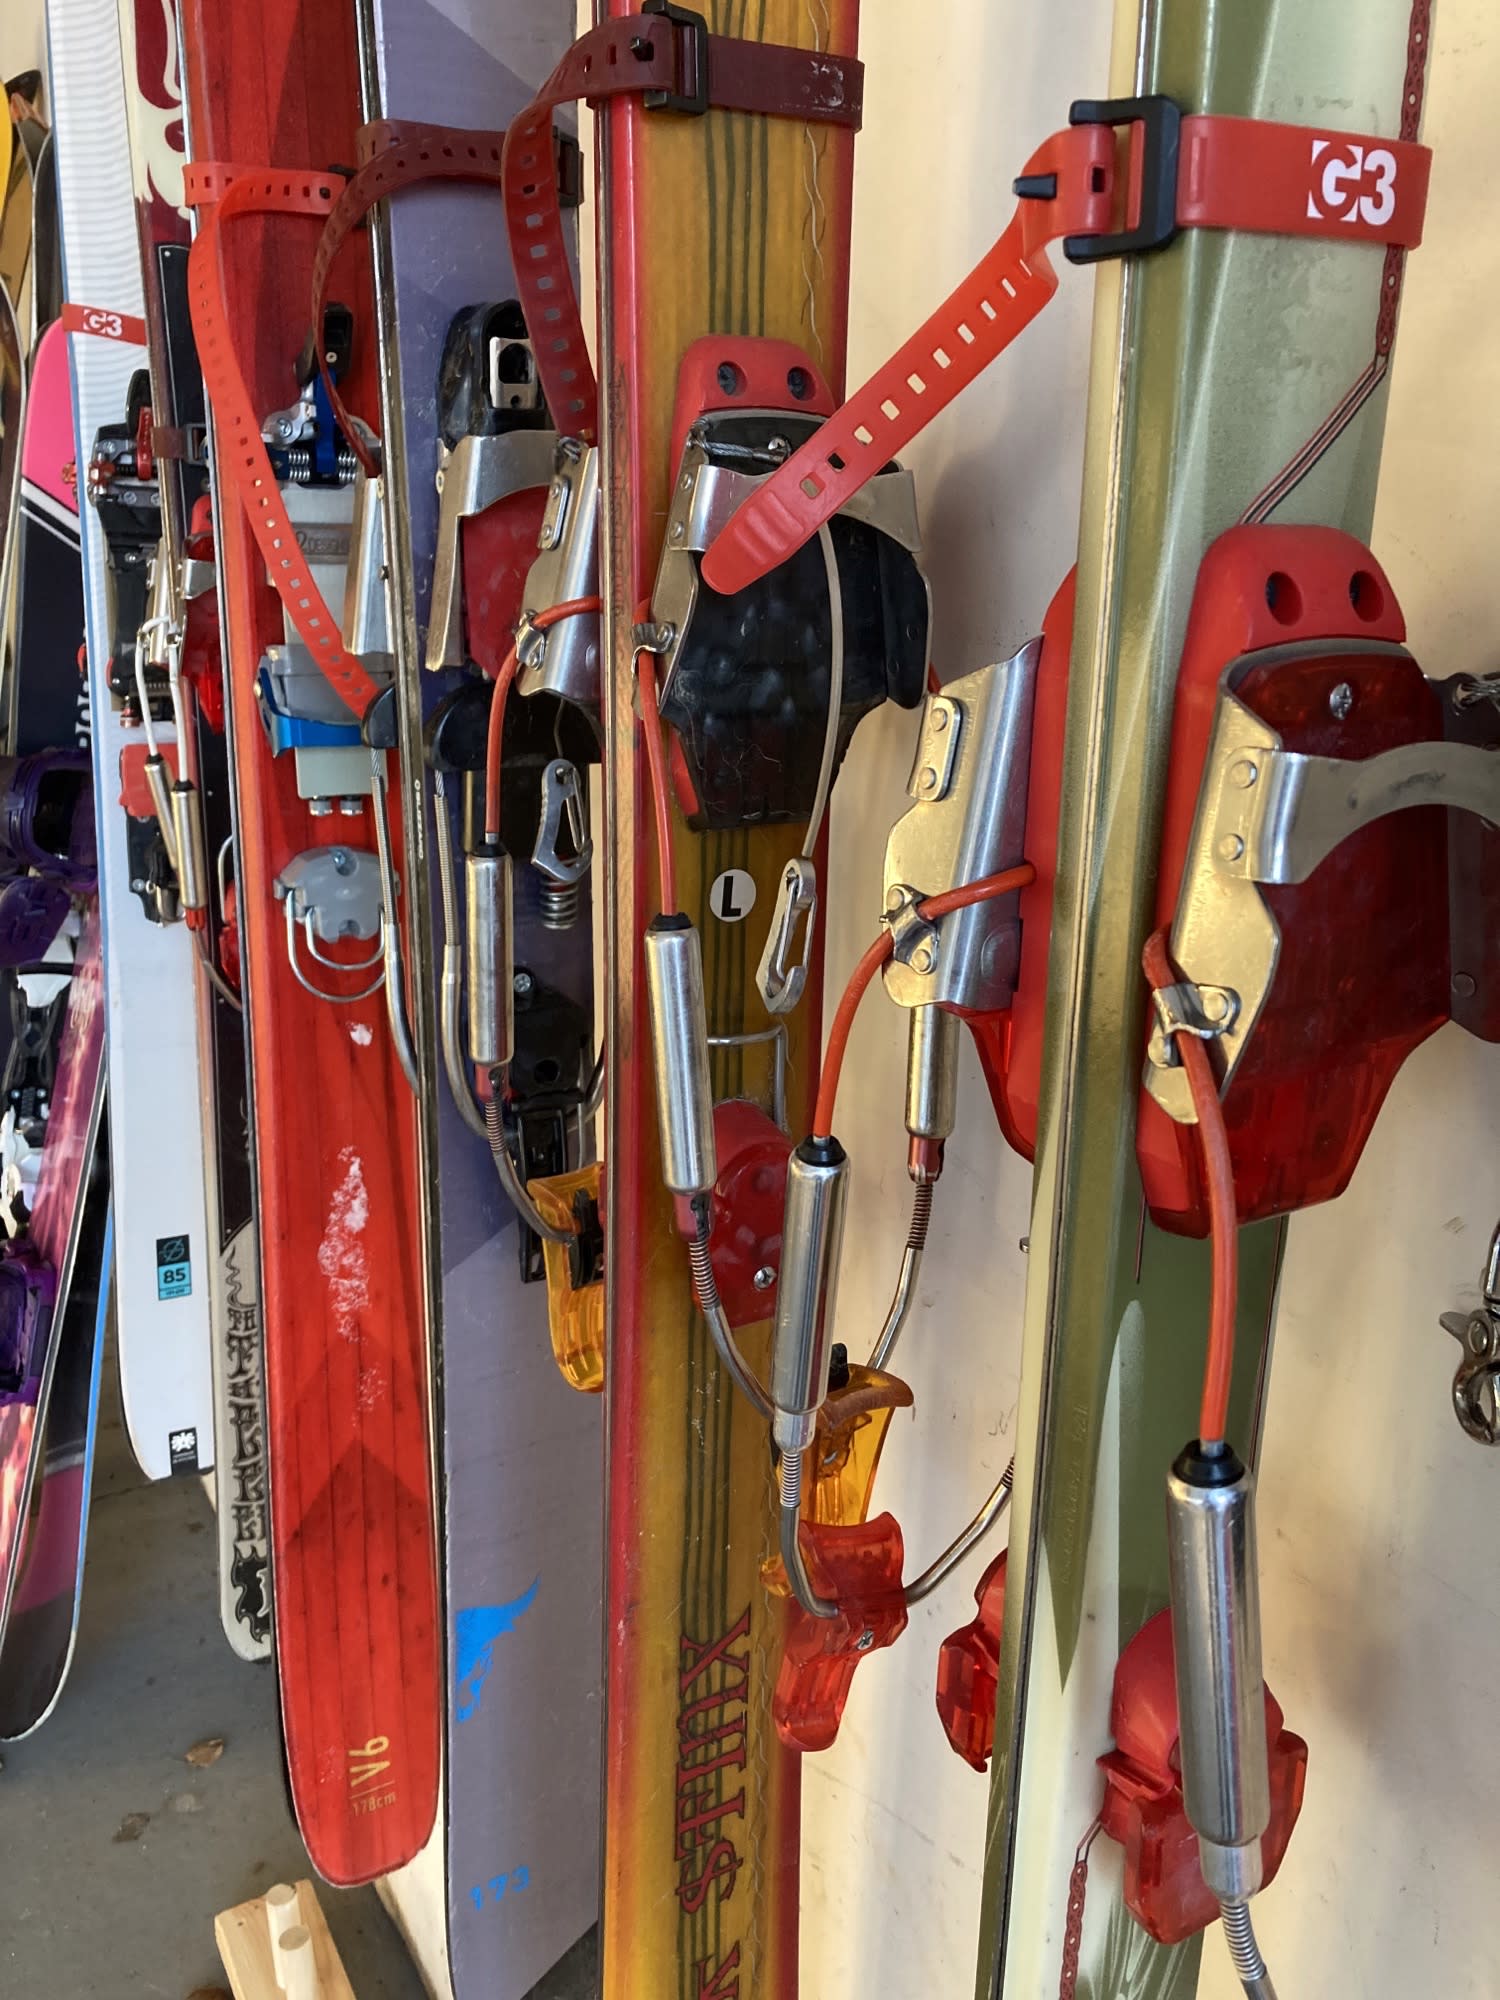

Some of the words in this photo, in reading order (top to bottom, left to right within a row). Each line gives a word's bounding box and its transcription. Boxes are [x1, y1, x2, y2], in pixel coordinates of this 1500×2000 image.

[1306, 139, 1397, 226] G3
[82, 308, 123, 337] G3
[721, 875, 742, 918] L
[163, 1267, 186, 1284] 85
[348, 1735, 391, 1788] V6
[467, 1864, 530, 1912] 173
